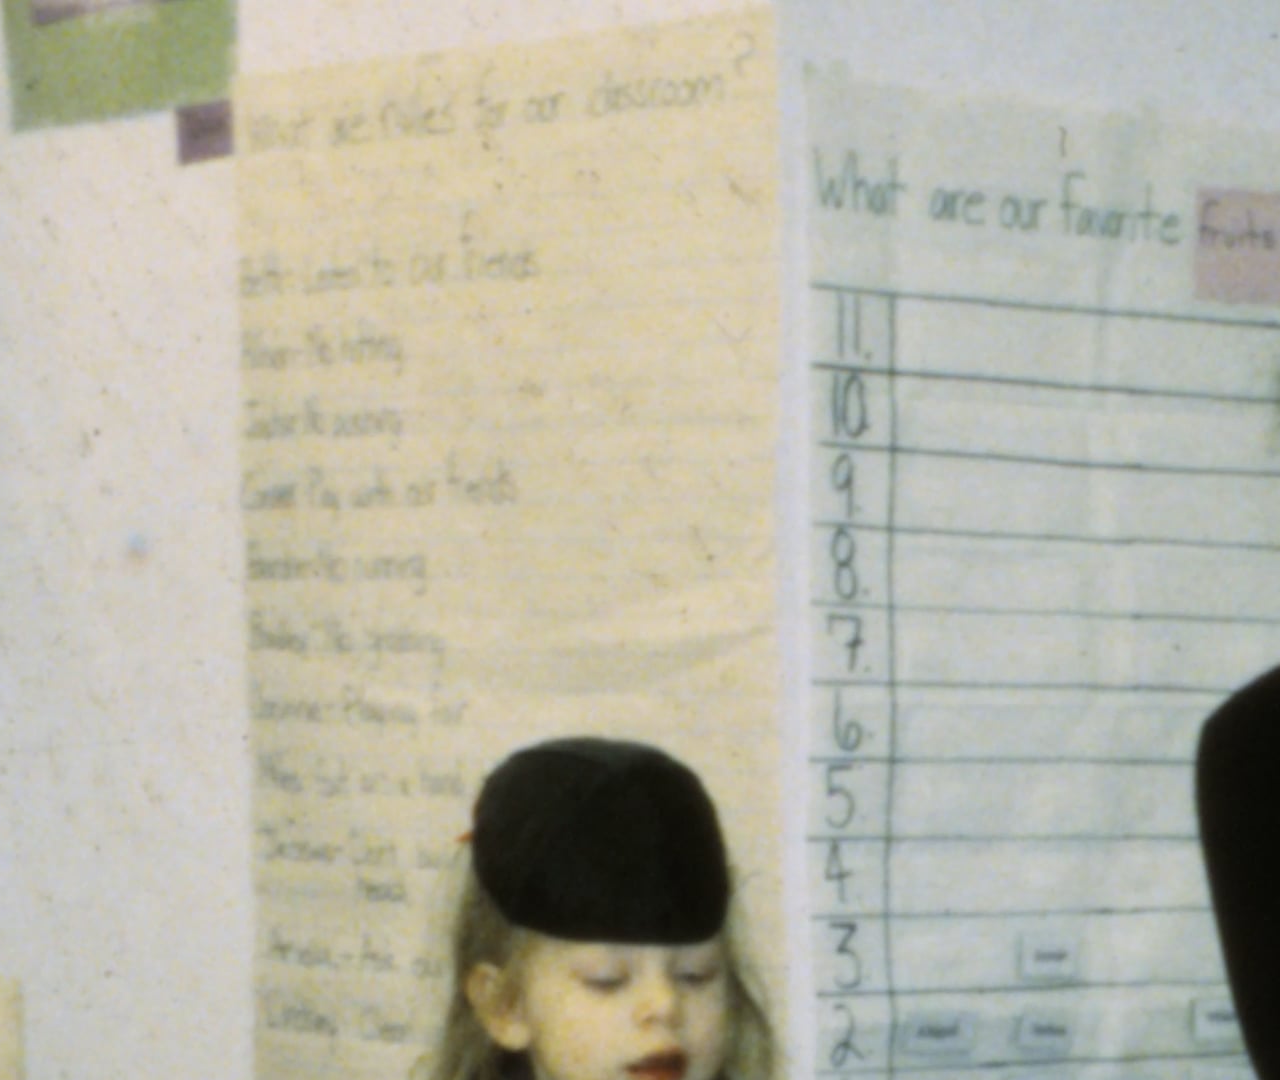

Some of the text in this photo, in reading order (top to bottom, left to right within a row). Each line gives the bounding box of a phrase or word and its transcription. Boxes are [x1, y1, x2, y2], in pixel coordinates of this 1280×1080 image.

[812, 146, 908, 216] What
[926, 183, 987, 228] are
[998, 190, 1047, 231] our
[829, 921, 863, 990] 3
[829, 1003, 865, 1068] 2
